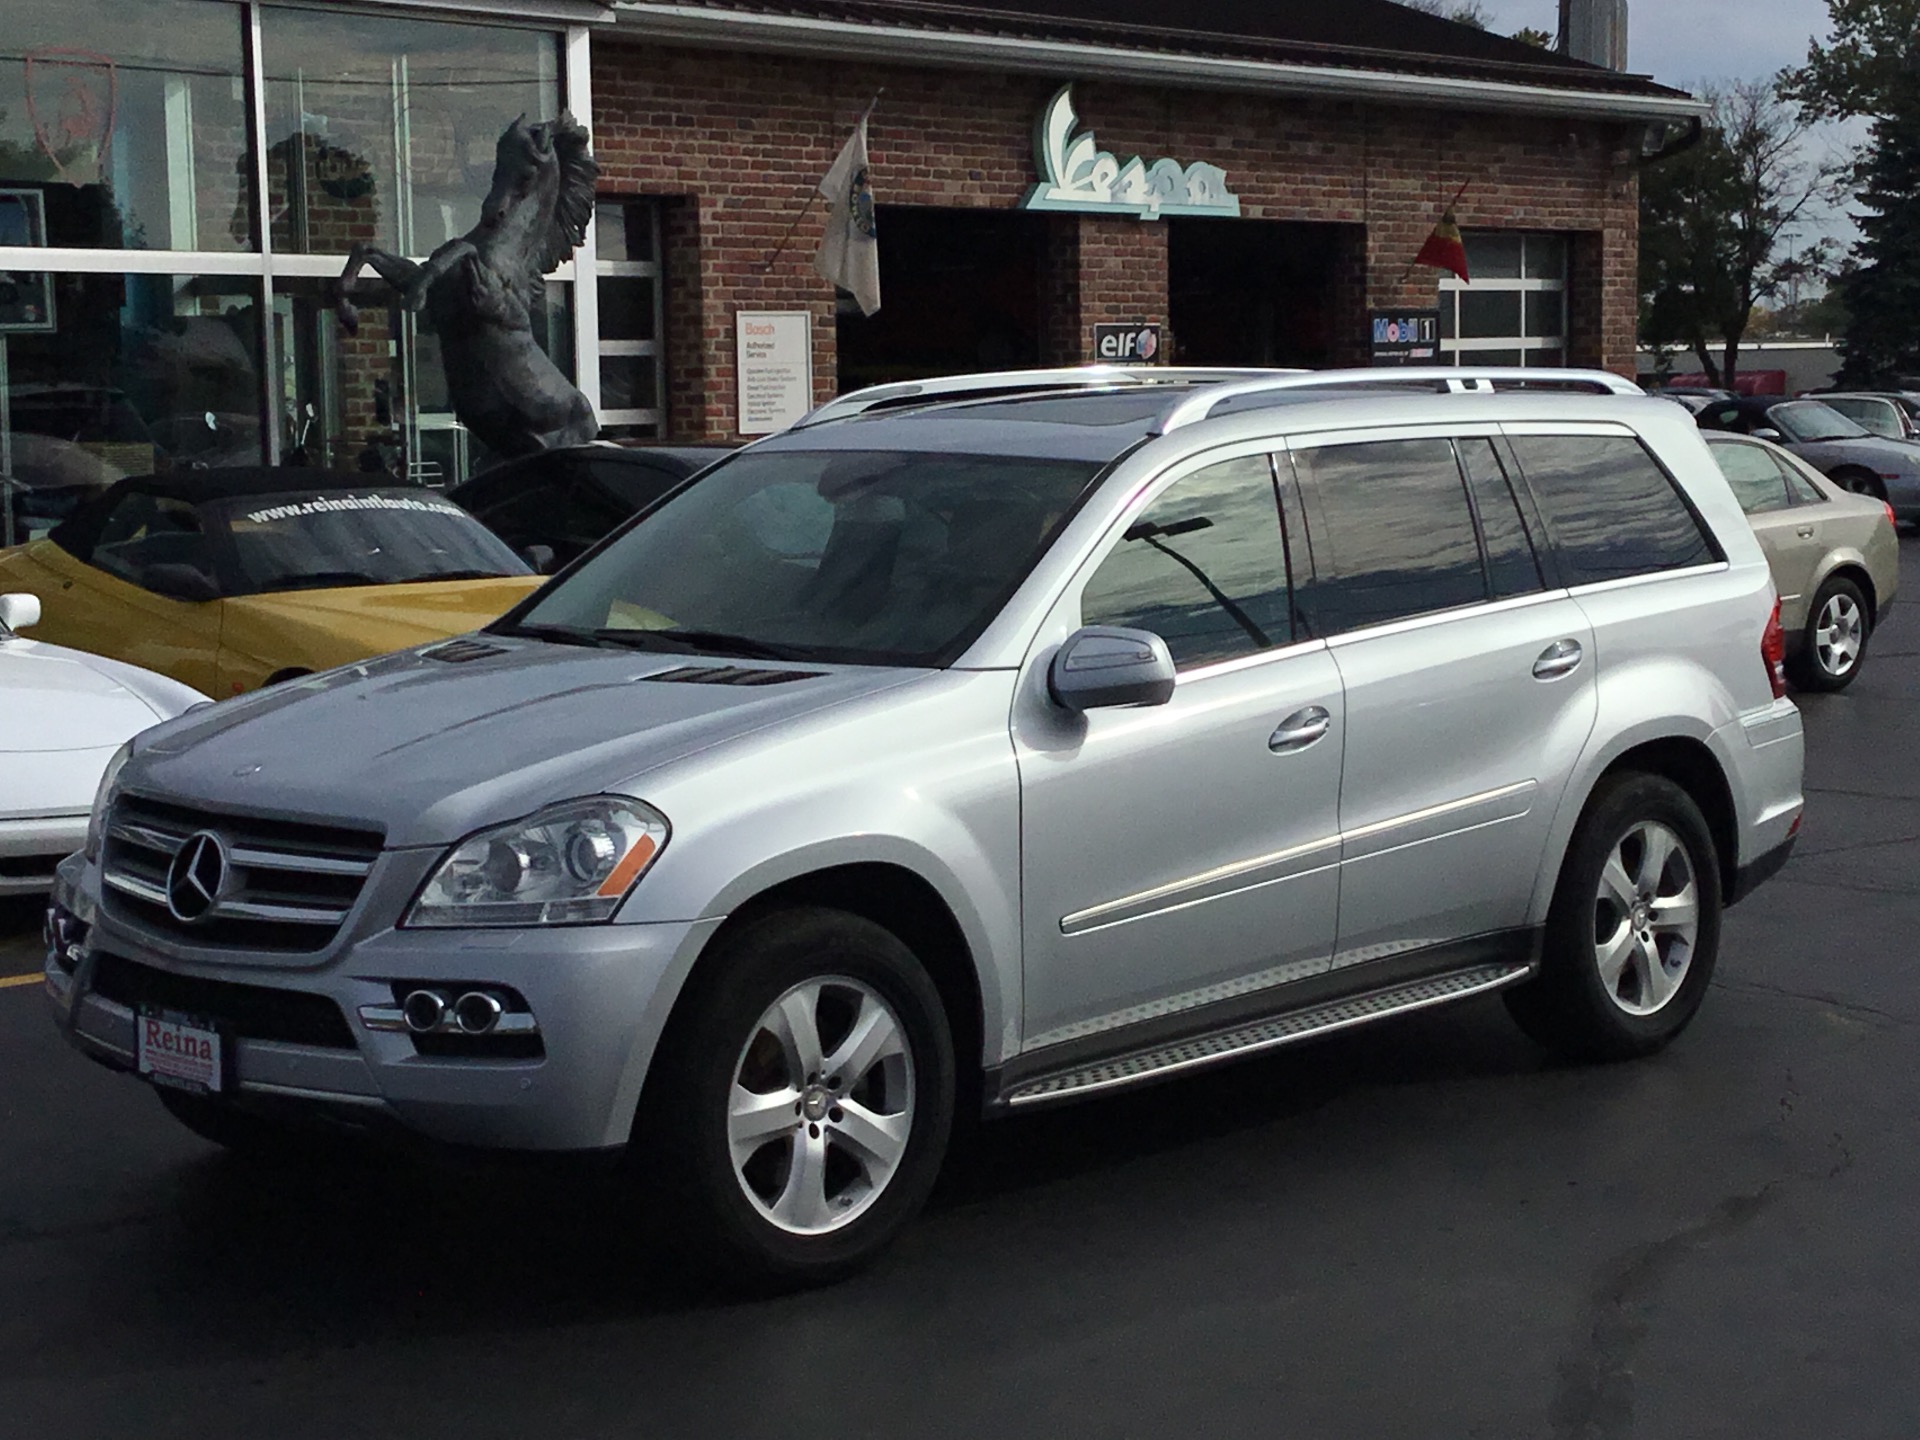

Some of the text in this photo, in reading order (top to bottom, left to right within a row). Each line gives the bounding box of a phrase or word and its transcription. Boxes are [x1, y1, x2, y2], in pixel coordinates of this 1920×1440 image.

[1040, 84, 1236, 214] Vespa
[745, 323, 774, 334] Bosch
[1373, 318, 1418, 343] Mobil
[1100, 332, 1136, 357] elf
[145, 1020, 212, 1060] Reina
